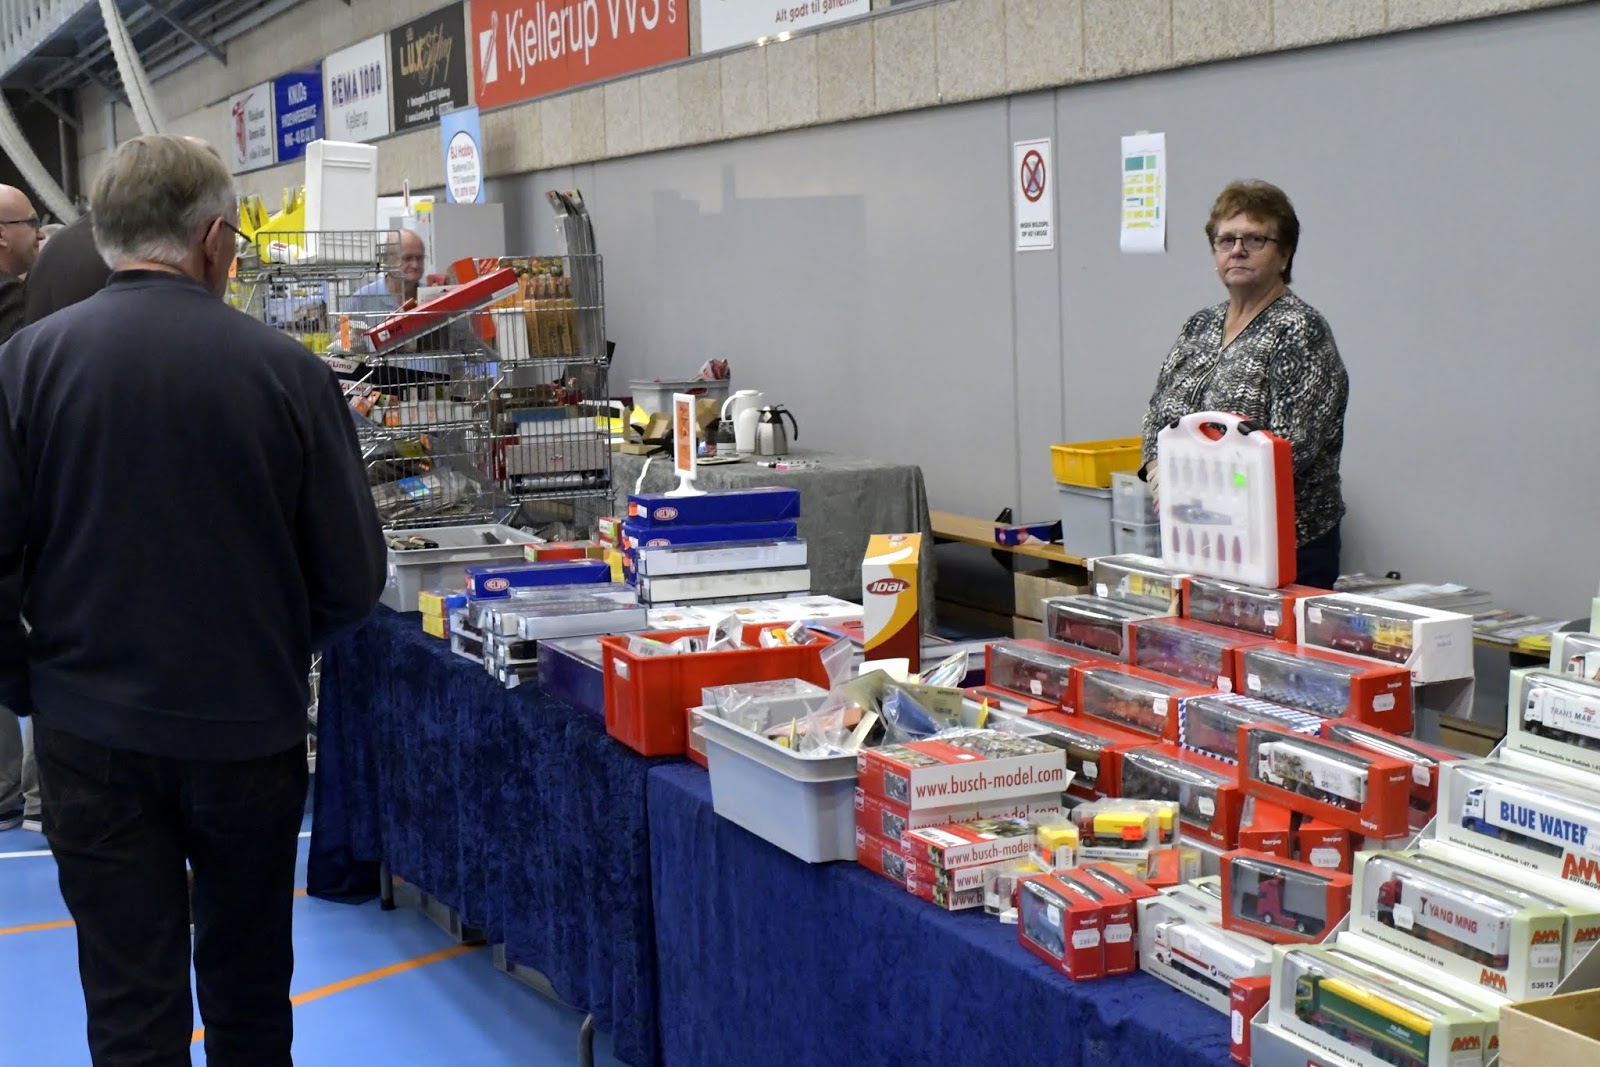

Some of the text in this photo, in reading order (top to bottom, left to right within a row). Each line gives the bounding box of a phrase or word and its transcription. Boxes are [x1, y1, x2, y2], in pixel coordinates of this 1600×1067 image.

[775, 8, 787, 23] Alt
[789, 2, 808, 22] godt
[811, 0, 820, 13] til
[506, 0, 599, 86] Kjellerup
[331, 70, 359, 109] REMA
[359, 60, 381, 99] 1000
[1550, 706, 1592, 722] TRANS MAR
[916, 765, 1063, 798] www.busch-model.com
[1500, 800, 1588, 846] BLUE WATER
[951, 889, 984, 906] www.b
[1430, 904, 1478, 934] YANG MING
